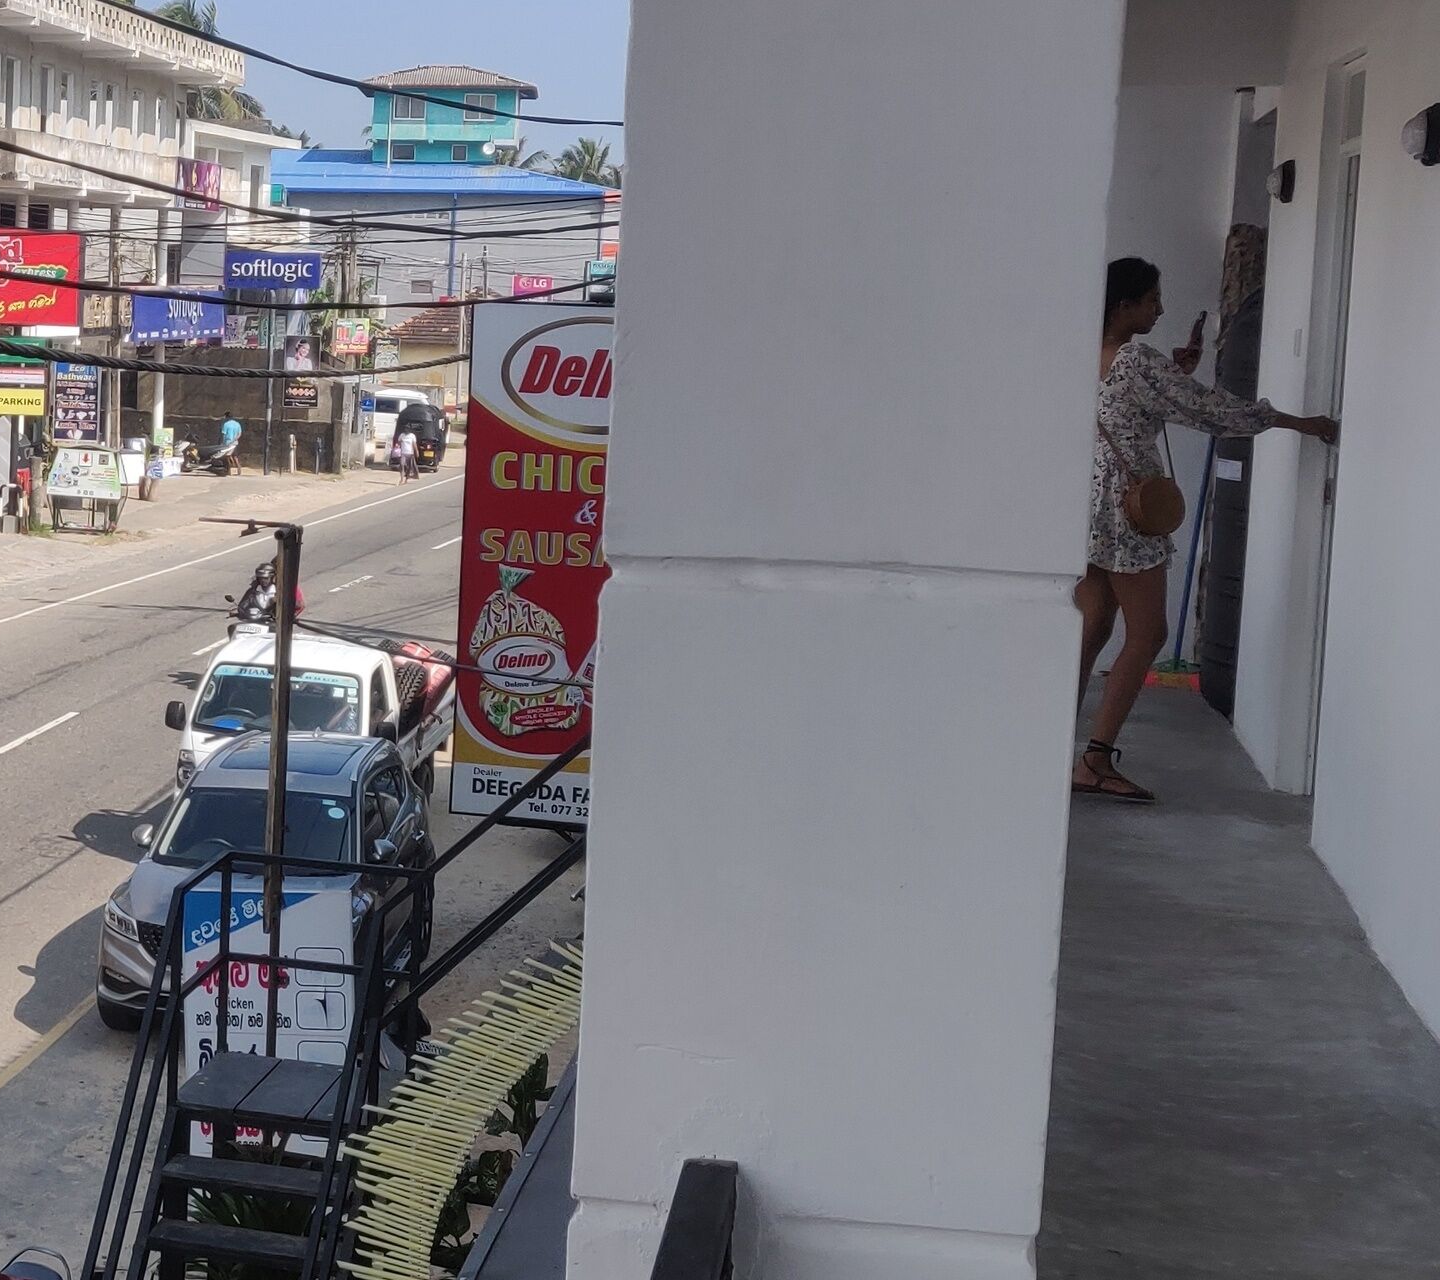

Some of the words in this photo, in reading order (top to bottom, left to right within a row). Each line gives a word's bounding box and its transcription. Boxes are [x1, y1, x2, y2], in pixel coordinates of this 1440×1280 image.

[231, 258, 314, 282] softlogic
[533, 279, 548, 288] LG
[575, 499, 597, 527] &
[497, 651, 549, 669] Delmo
[473, 766, 503, 778] Dealer
[528, 802, 548, 813] Tel.
[551, 804, 572, 816] 077
